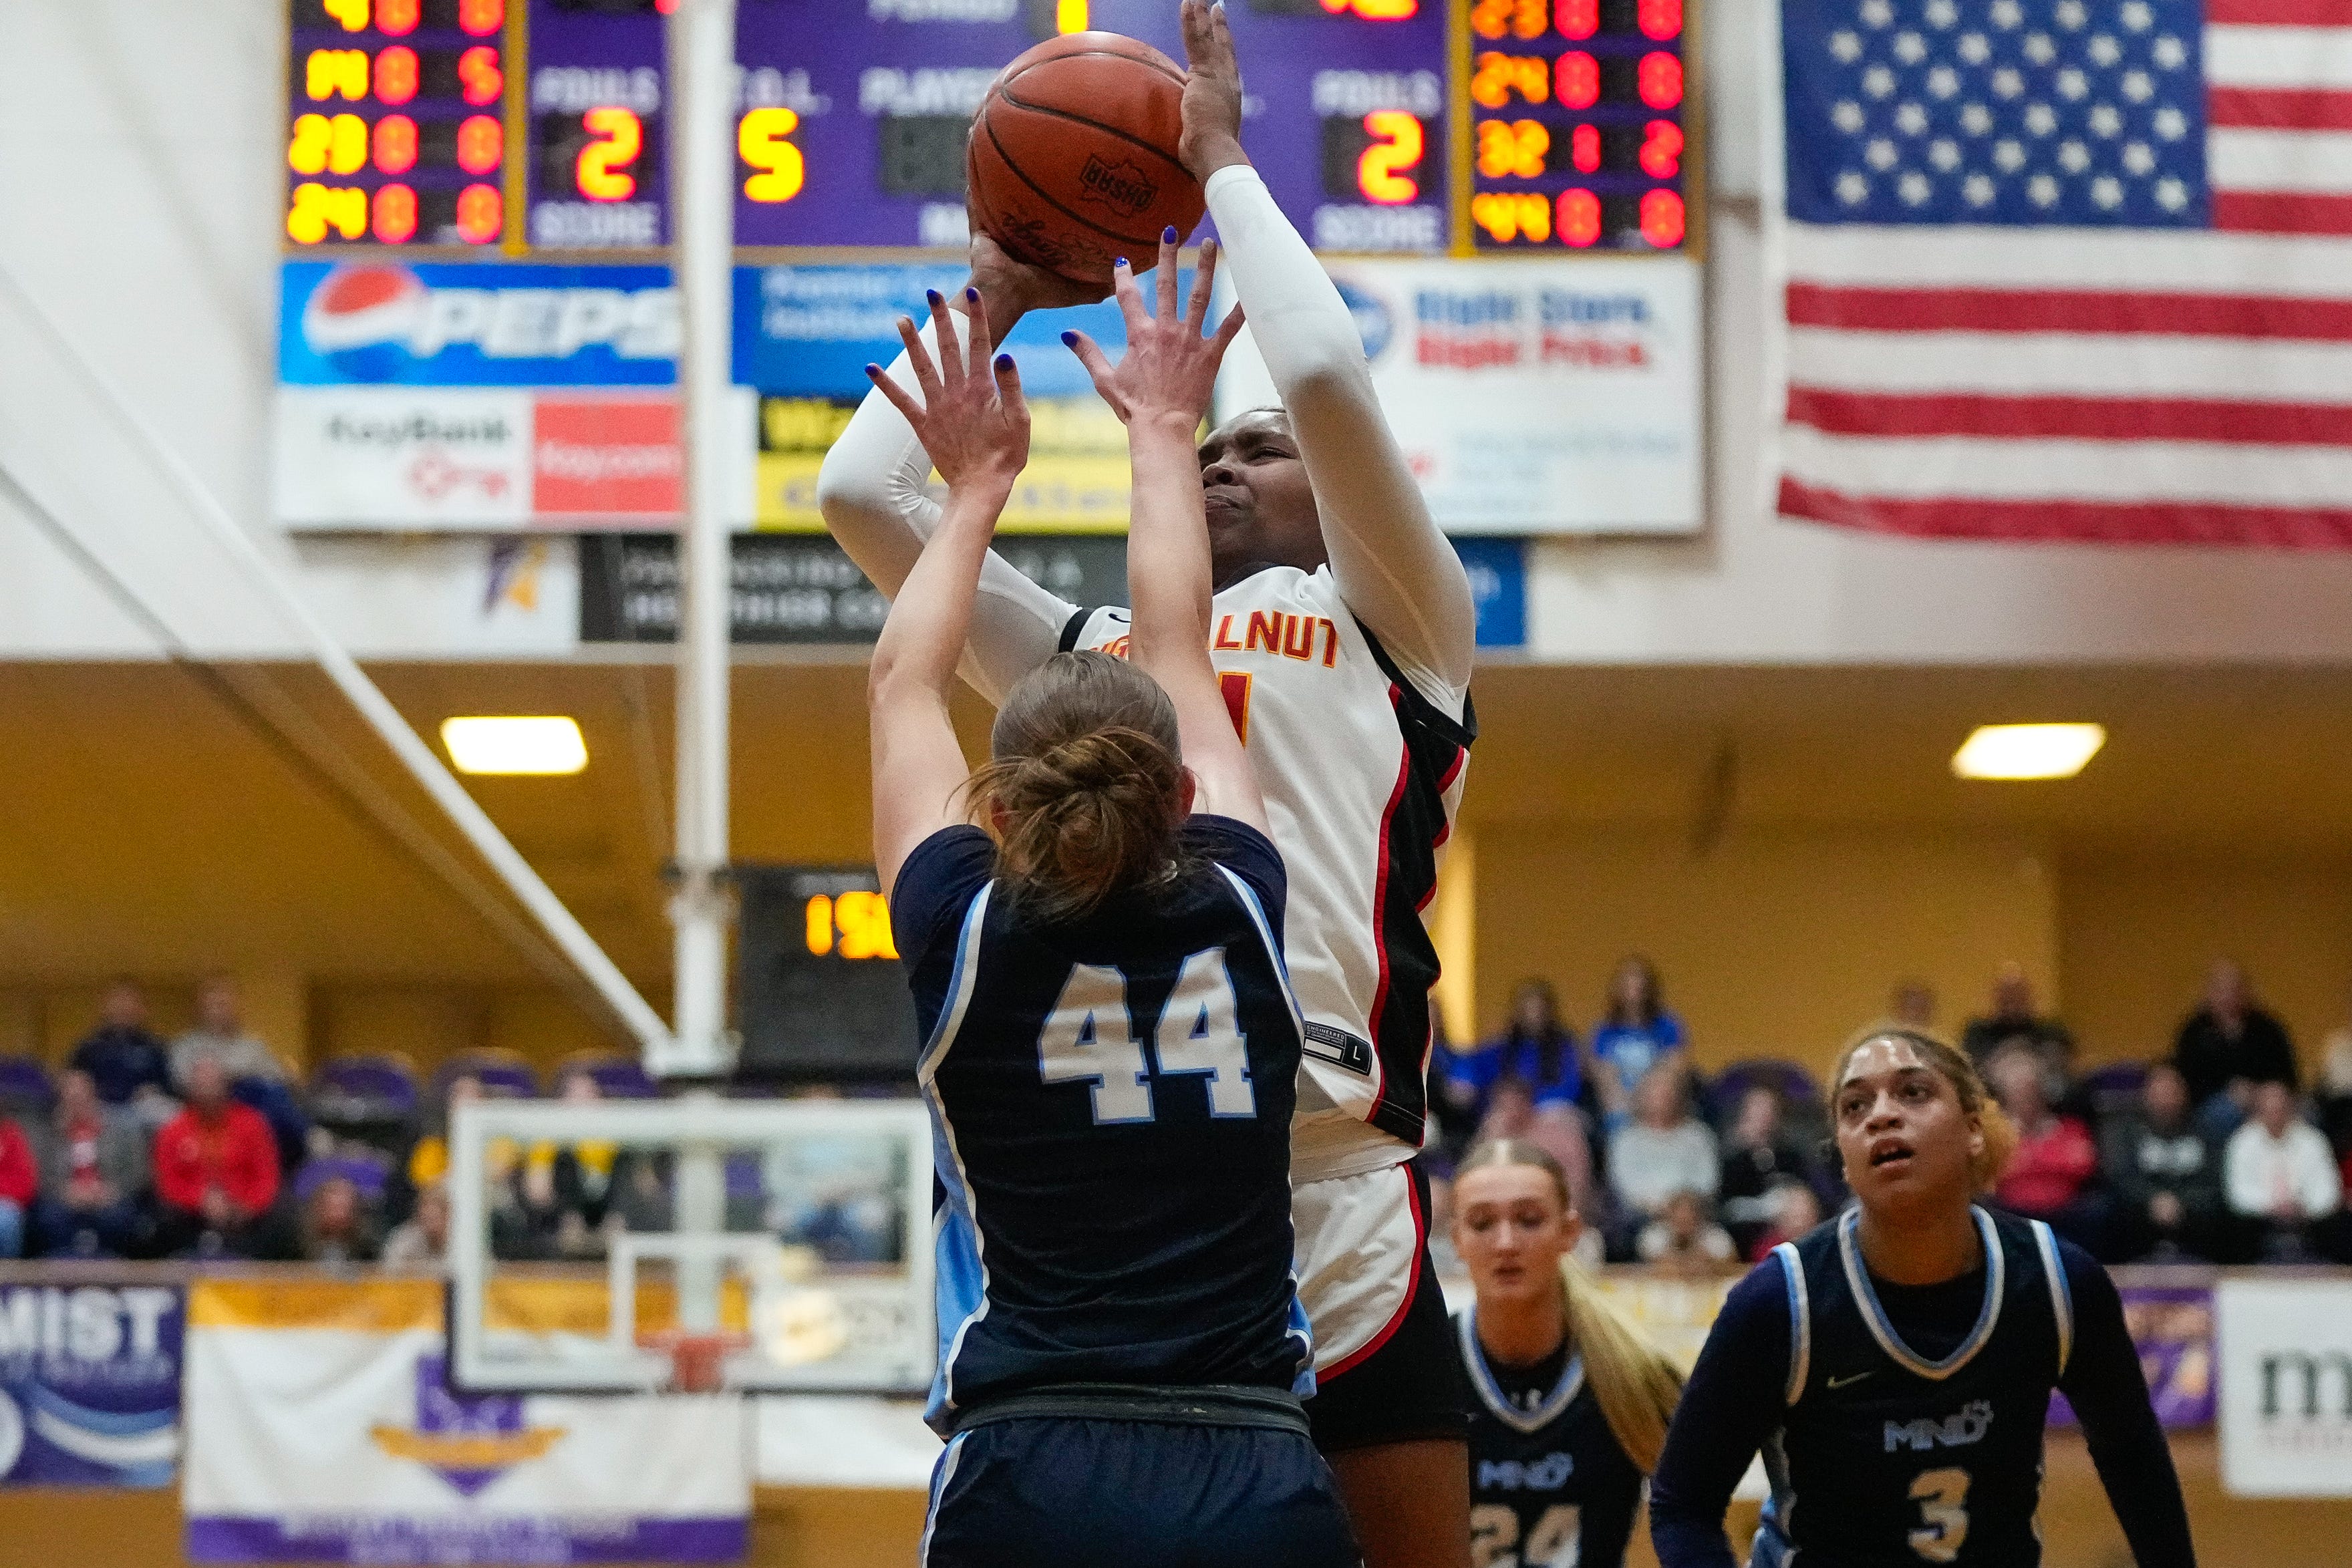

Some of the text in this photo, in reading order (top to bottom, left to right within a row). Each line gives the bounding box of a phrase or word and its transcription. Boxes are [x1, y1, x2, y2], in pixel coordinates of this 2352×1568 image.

[458, 45, 504, 106] 5
[534, 67, 660, 114] FOULS
[1312, 69, 1441, 116] FOULS
[1471, 51, 1549, 108] 24
[577, 106, 643, 202] 2
[738, 107, 804, 202] 5
[1358, 110, 1425, 205] 2
[1573, 124, 1600, 174] 1
[1640, 120, 1684, 179] 2
[534, 202, 659, 245] SCORE
[1314, 204, 1440, 248] SCORE
[1472, 192, 1550, 242] 44
[1208, 609, 1338, 668] LNUT
[1037, 946, 1256, 1125] 44
[1353, 1046, 1360, 1061] L
[1469, 1505, 1582, 1568] 24
[1907, 1467, 1972, 1564] 3
